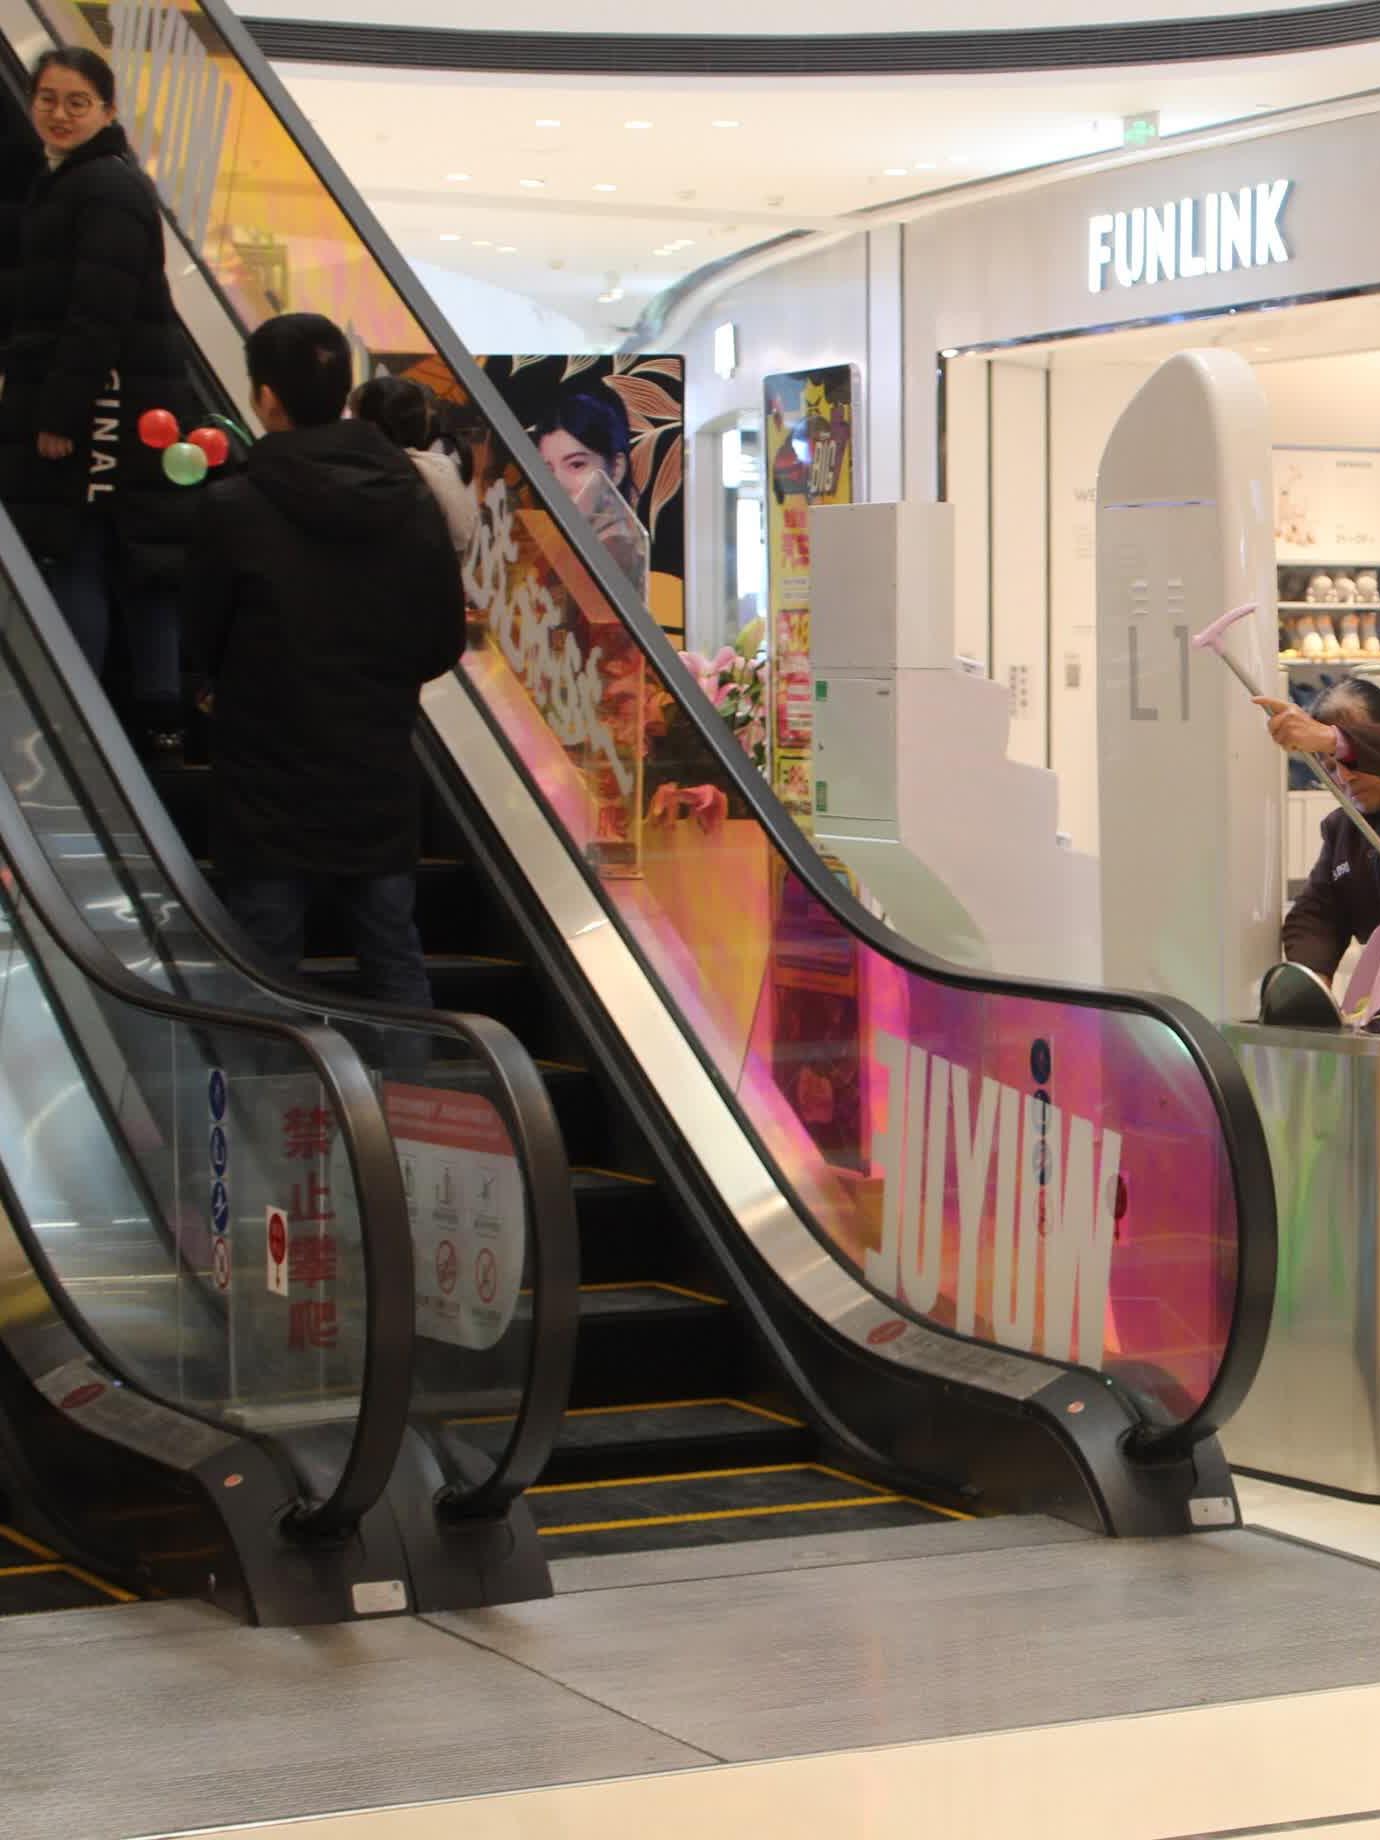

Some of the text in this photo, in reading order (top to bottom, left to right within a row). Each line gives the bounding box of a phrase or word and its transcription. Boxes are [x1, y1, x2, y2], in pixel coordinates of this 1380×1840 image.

[1088, 178, 1290, 294] FUNLINK
[283, 1106, 340, 1351] 禁止攀爬
